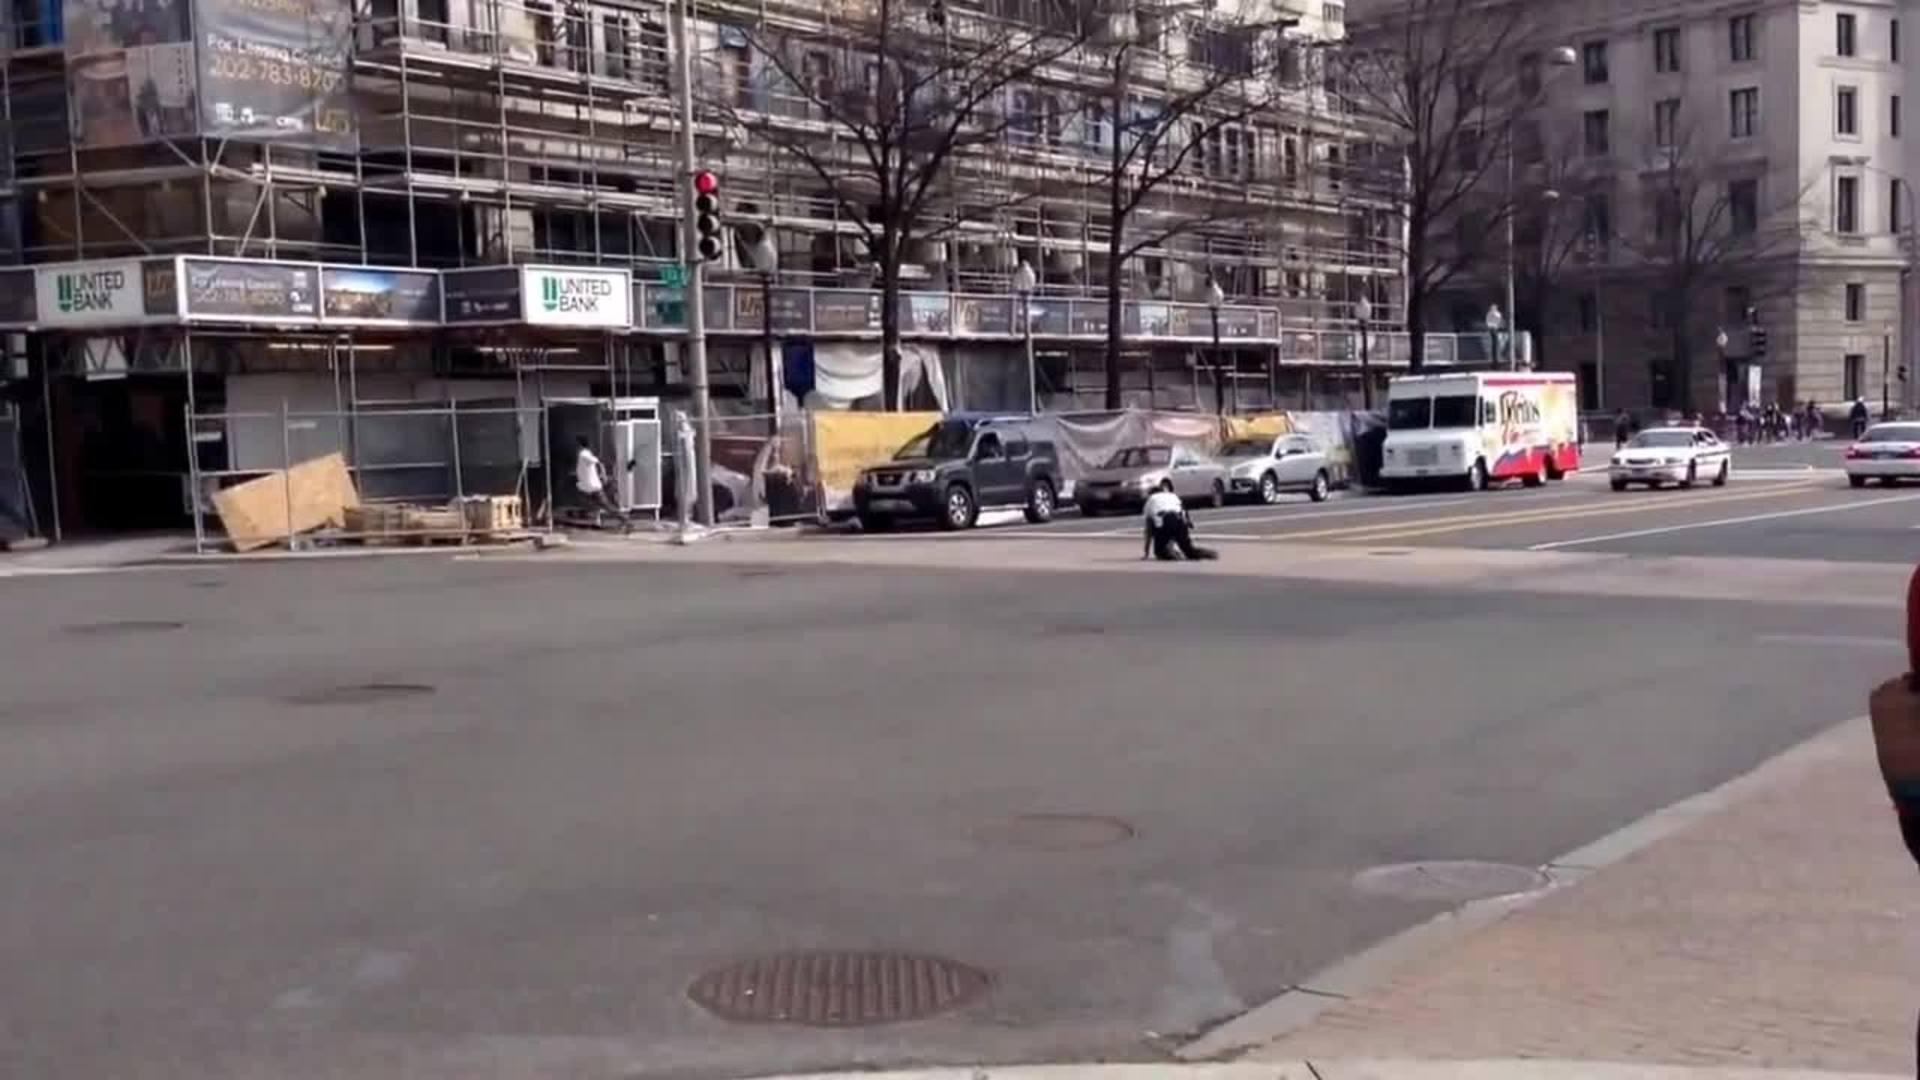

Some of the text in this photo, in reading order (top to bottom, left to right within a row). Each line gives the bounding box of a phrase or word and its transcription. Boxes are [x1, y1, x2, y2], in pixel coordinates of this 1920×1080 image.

[73, 271, 125, 292] UNITED
[559, 277, 612, 296] UNITED
[73, 292, 113, 311] BANK
[559, 296, 600, 312] BANK
